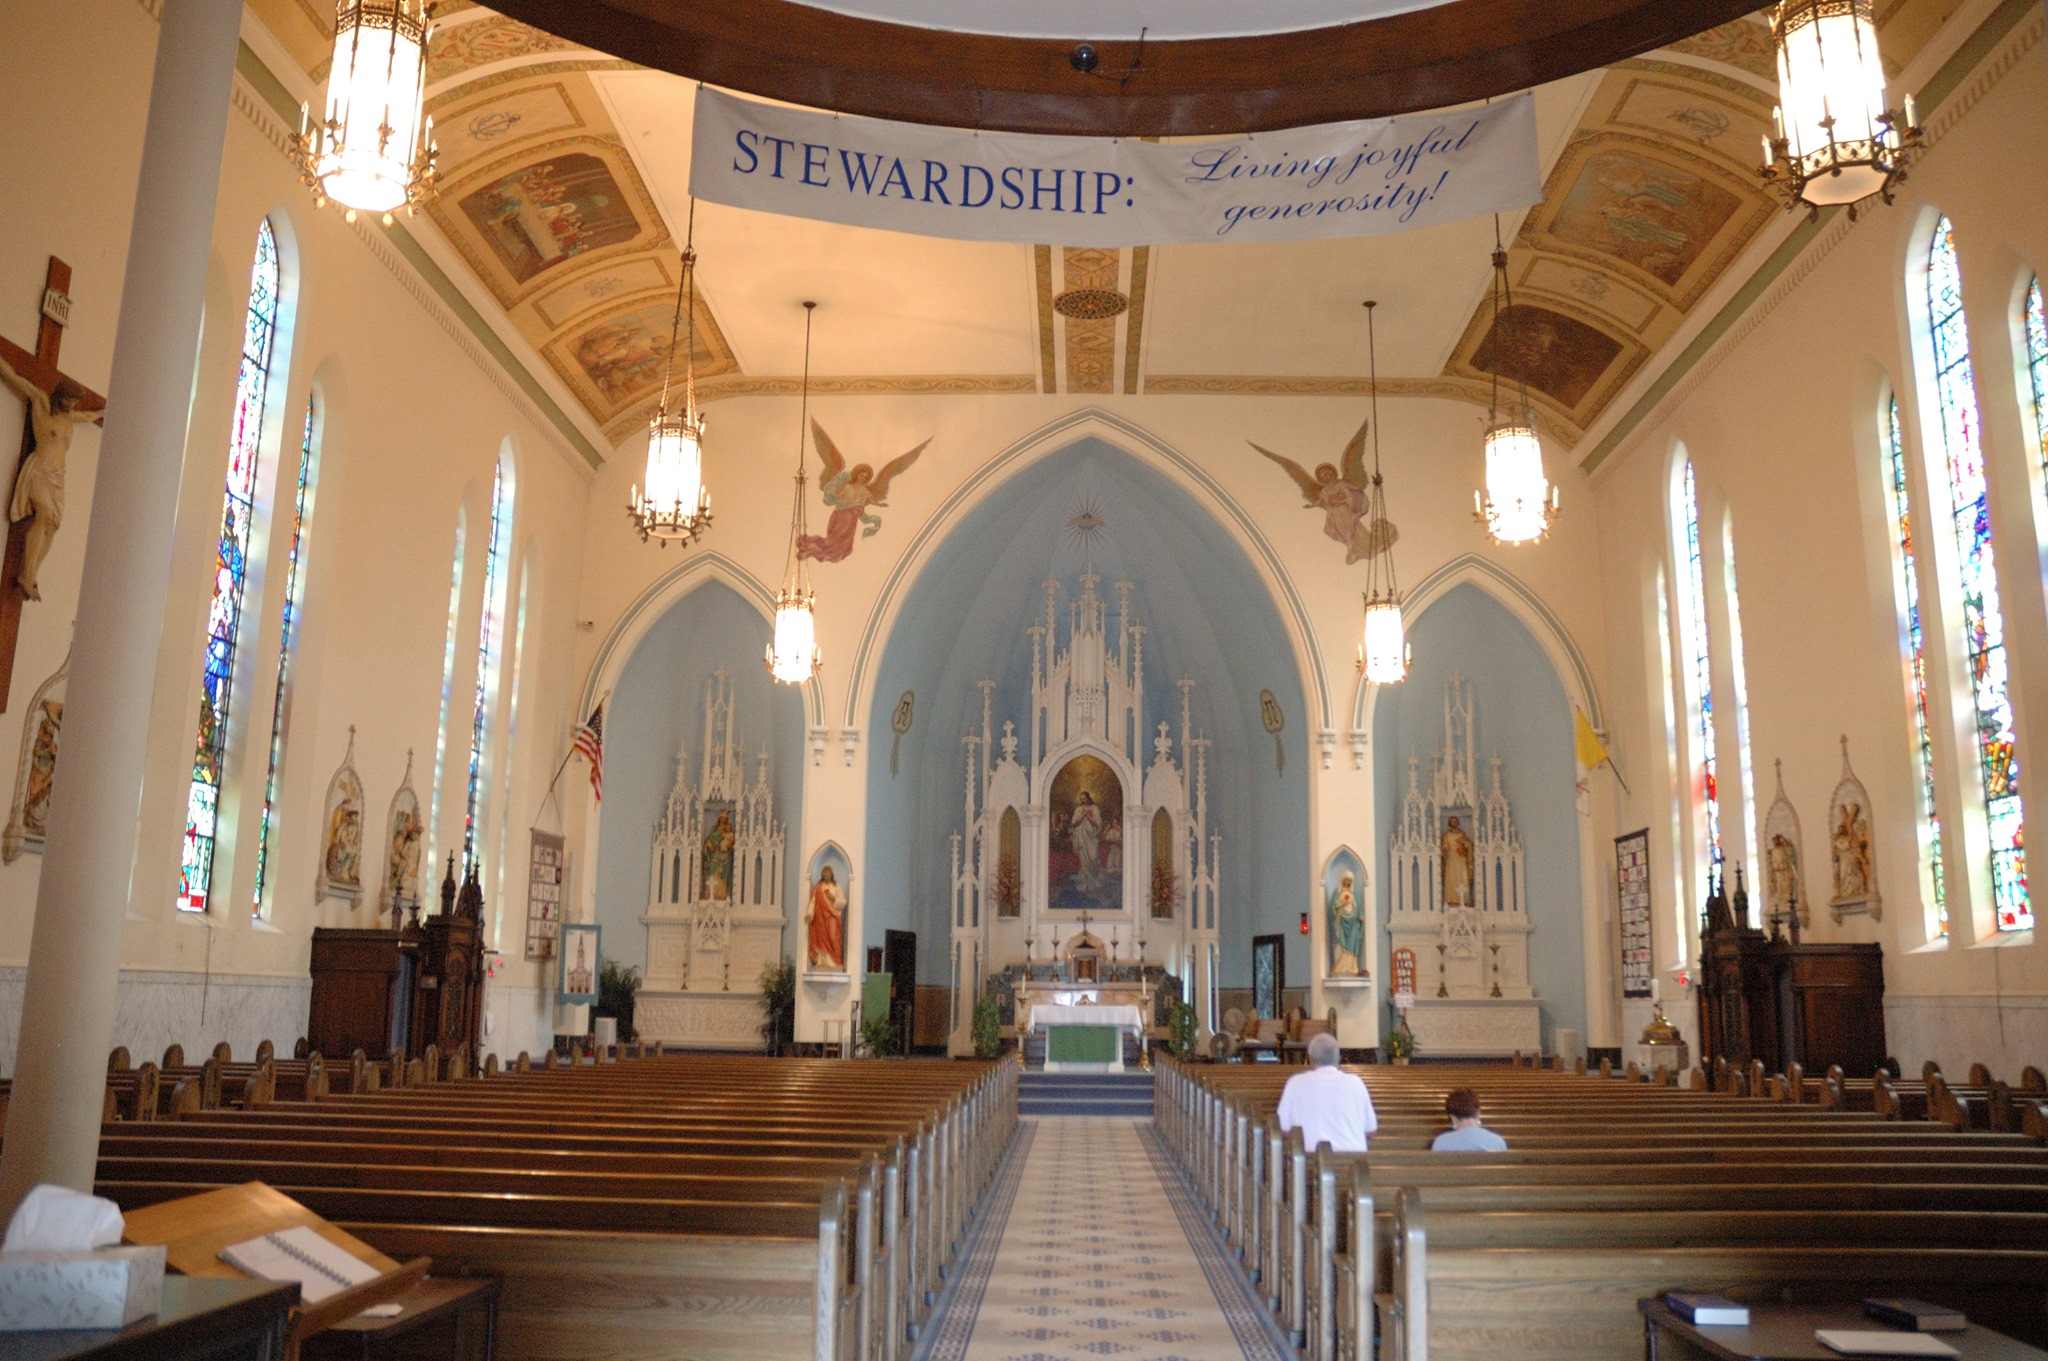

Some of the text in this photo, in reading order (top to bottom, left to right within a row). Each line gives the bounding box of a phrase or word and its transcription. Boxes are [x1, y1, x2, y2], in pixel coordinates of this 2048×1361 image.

[733, 129, 1134, 215] STEWARDSHIP:
[1184, 120, 1480, 189] Living joyful
[1216, 170, 1449, 236] generosity!
[47, 293, 69, 321] INRI
